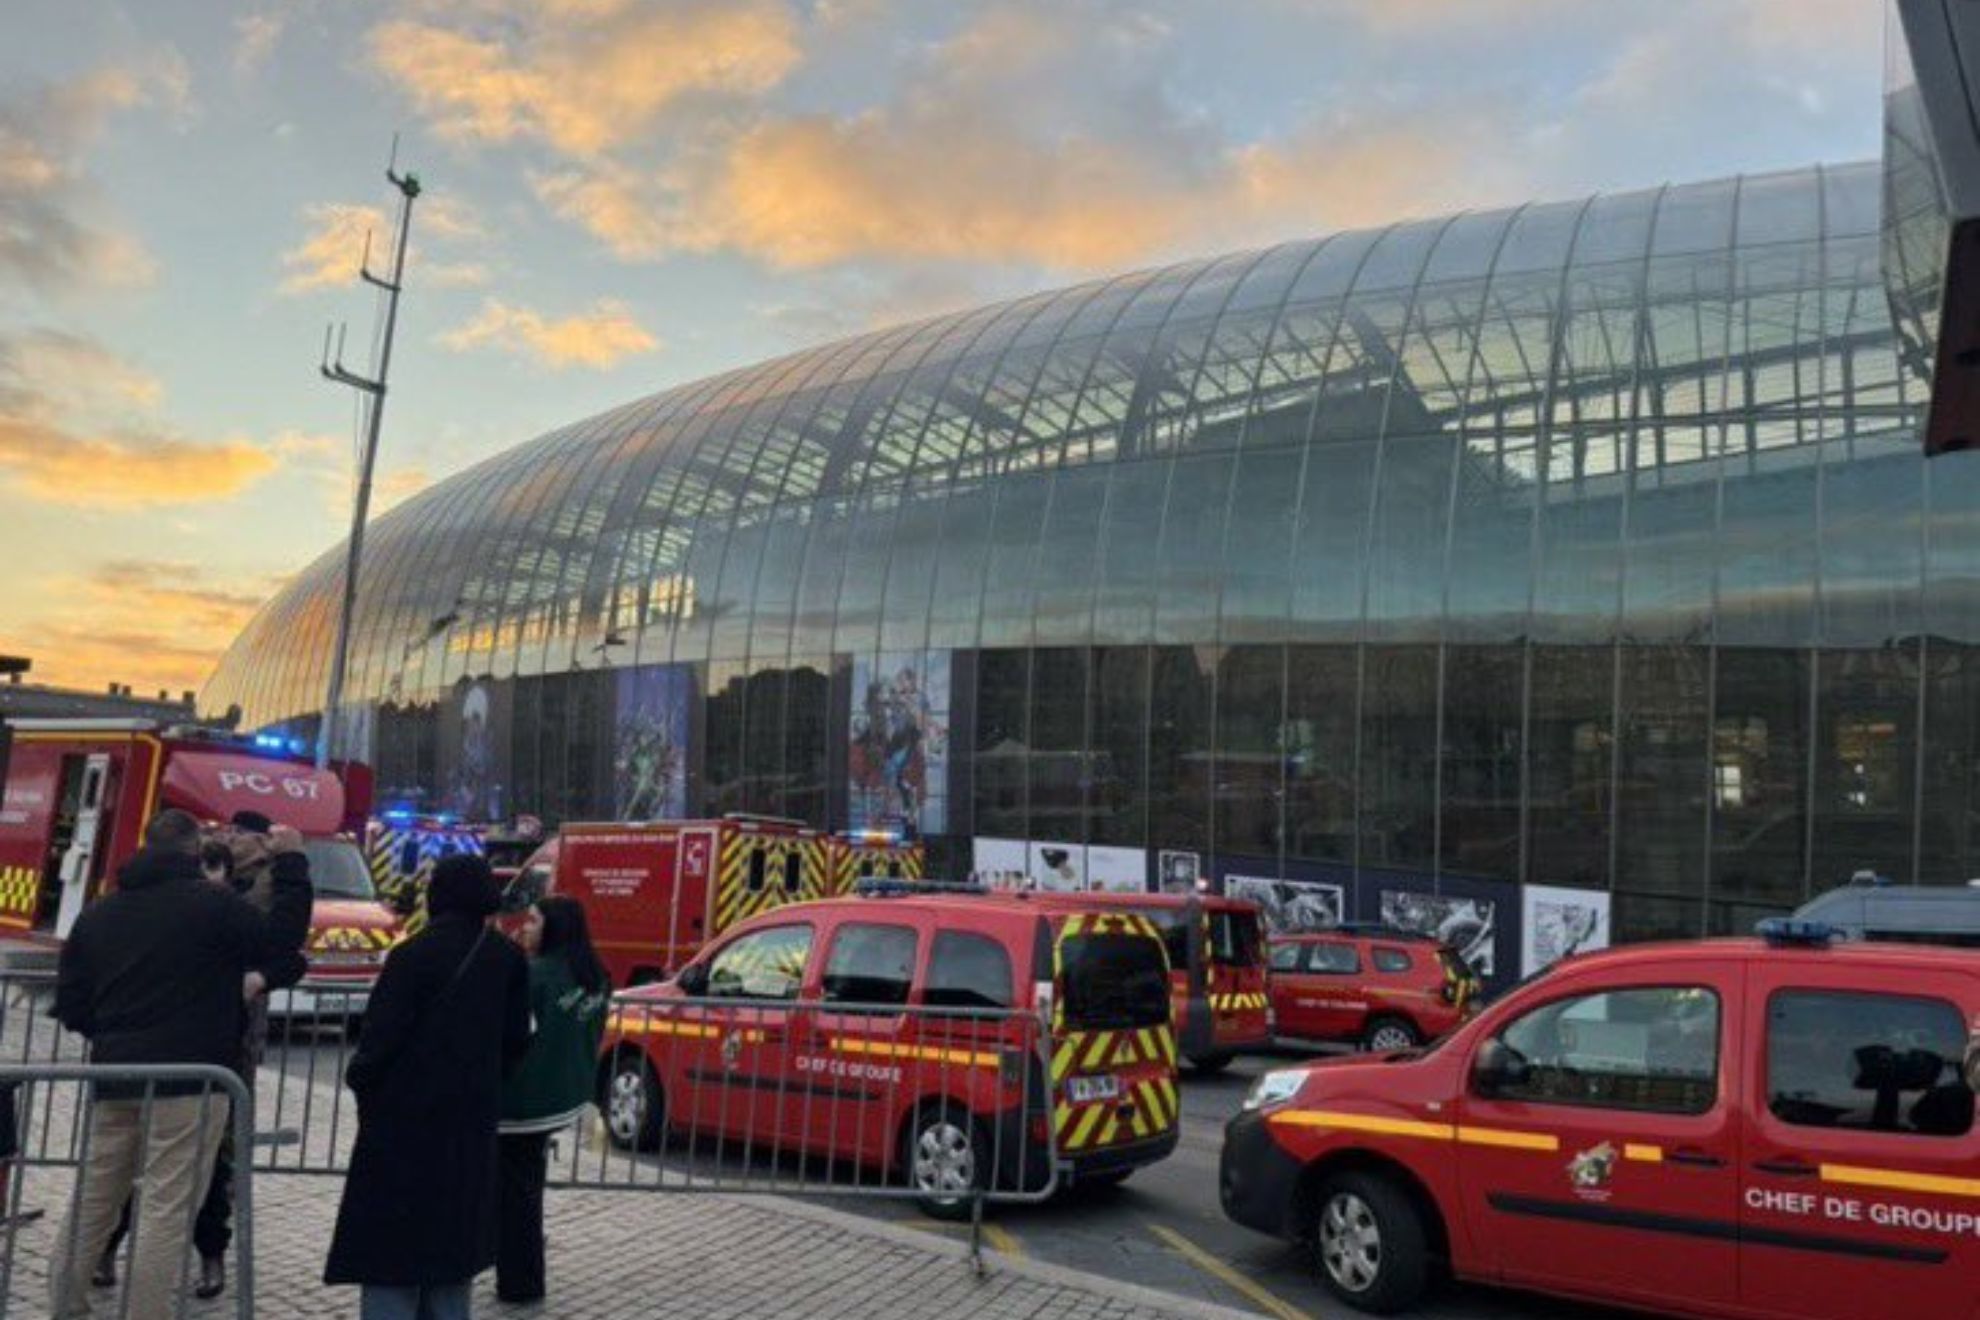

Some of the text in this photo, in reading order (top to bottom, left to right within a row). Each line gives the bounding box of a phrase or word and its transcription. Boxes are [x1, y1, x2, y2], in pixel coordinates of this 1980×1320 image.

[218, 771, 318, 799] PC 67
[1744, 1187, 1817, 1214] CHEF
[1825, 1197, 1862, 1221] DE
